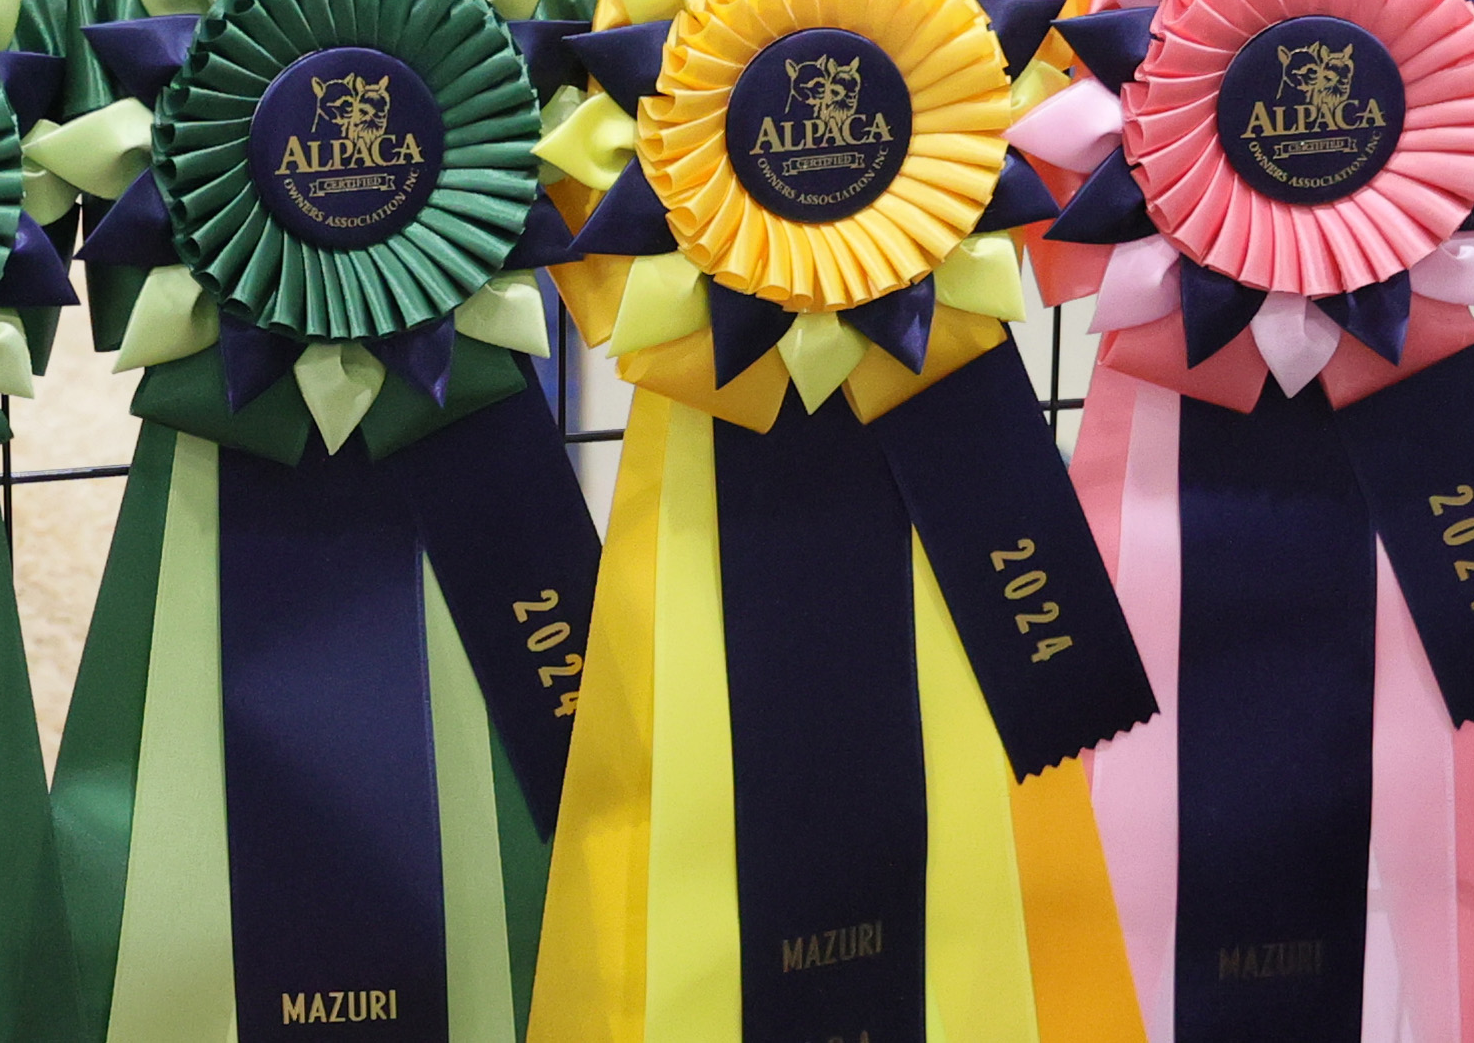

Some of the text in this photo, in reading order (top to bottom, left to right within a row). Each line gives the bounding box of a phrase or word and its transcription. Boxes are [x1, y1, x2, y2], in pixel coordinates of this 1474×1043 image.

[749, 112, 894, 155] ALPACA
[1240, 98, 1386, 138] ALPACA
[274, 133, 424, 175] ALPACA
[757, 145, 889, 205] OWNERS ASSOCIATION INC
[796, 155, 852, 169] CERTIFIED
[1249, 131, 1381, 188] OWNERS ASSOCIATION INC
[284, 168, 420, 228] OWNERS ASSOCIATION INC
[324, 177, 382, 190] CERTIFIED
[990, 538, 1073, 663] 2024
[512, 588, 584, 718] 2024
[782, 920, 882, 973] MAZURI
[1218, 939, 1325, 979] MAZURI
[281, 989, 398, 1025] MAZURI
